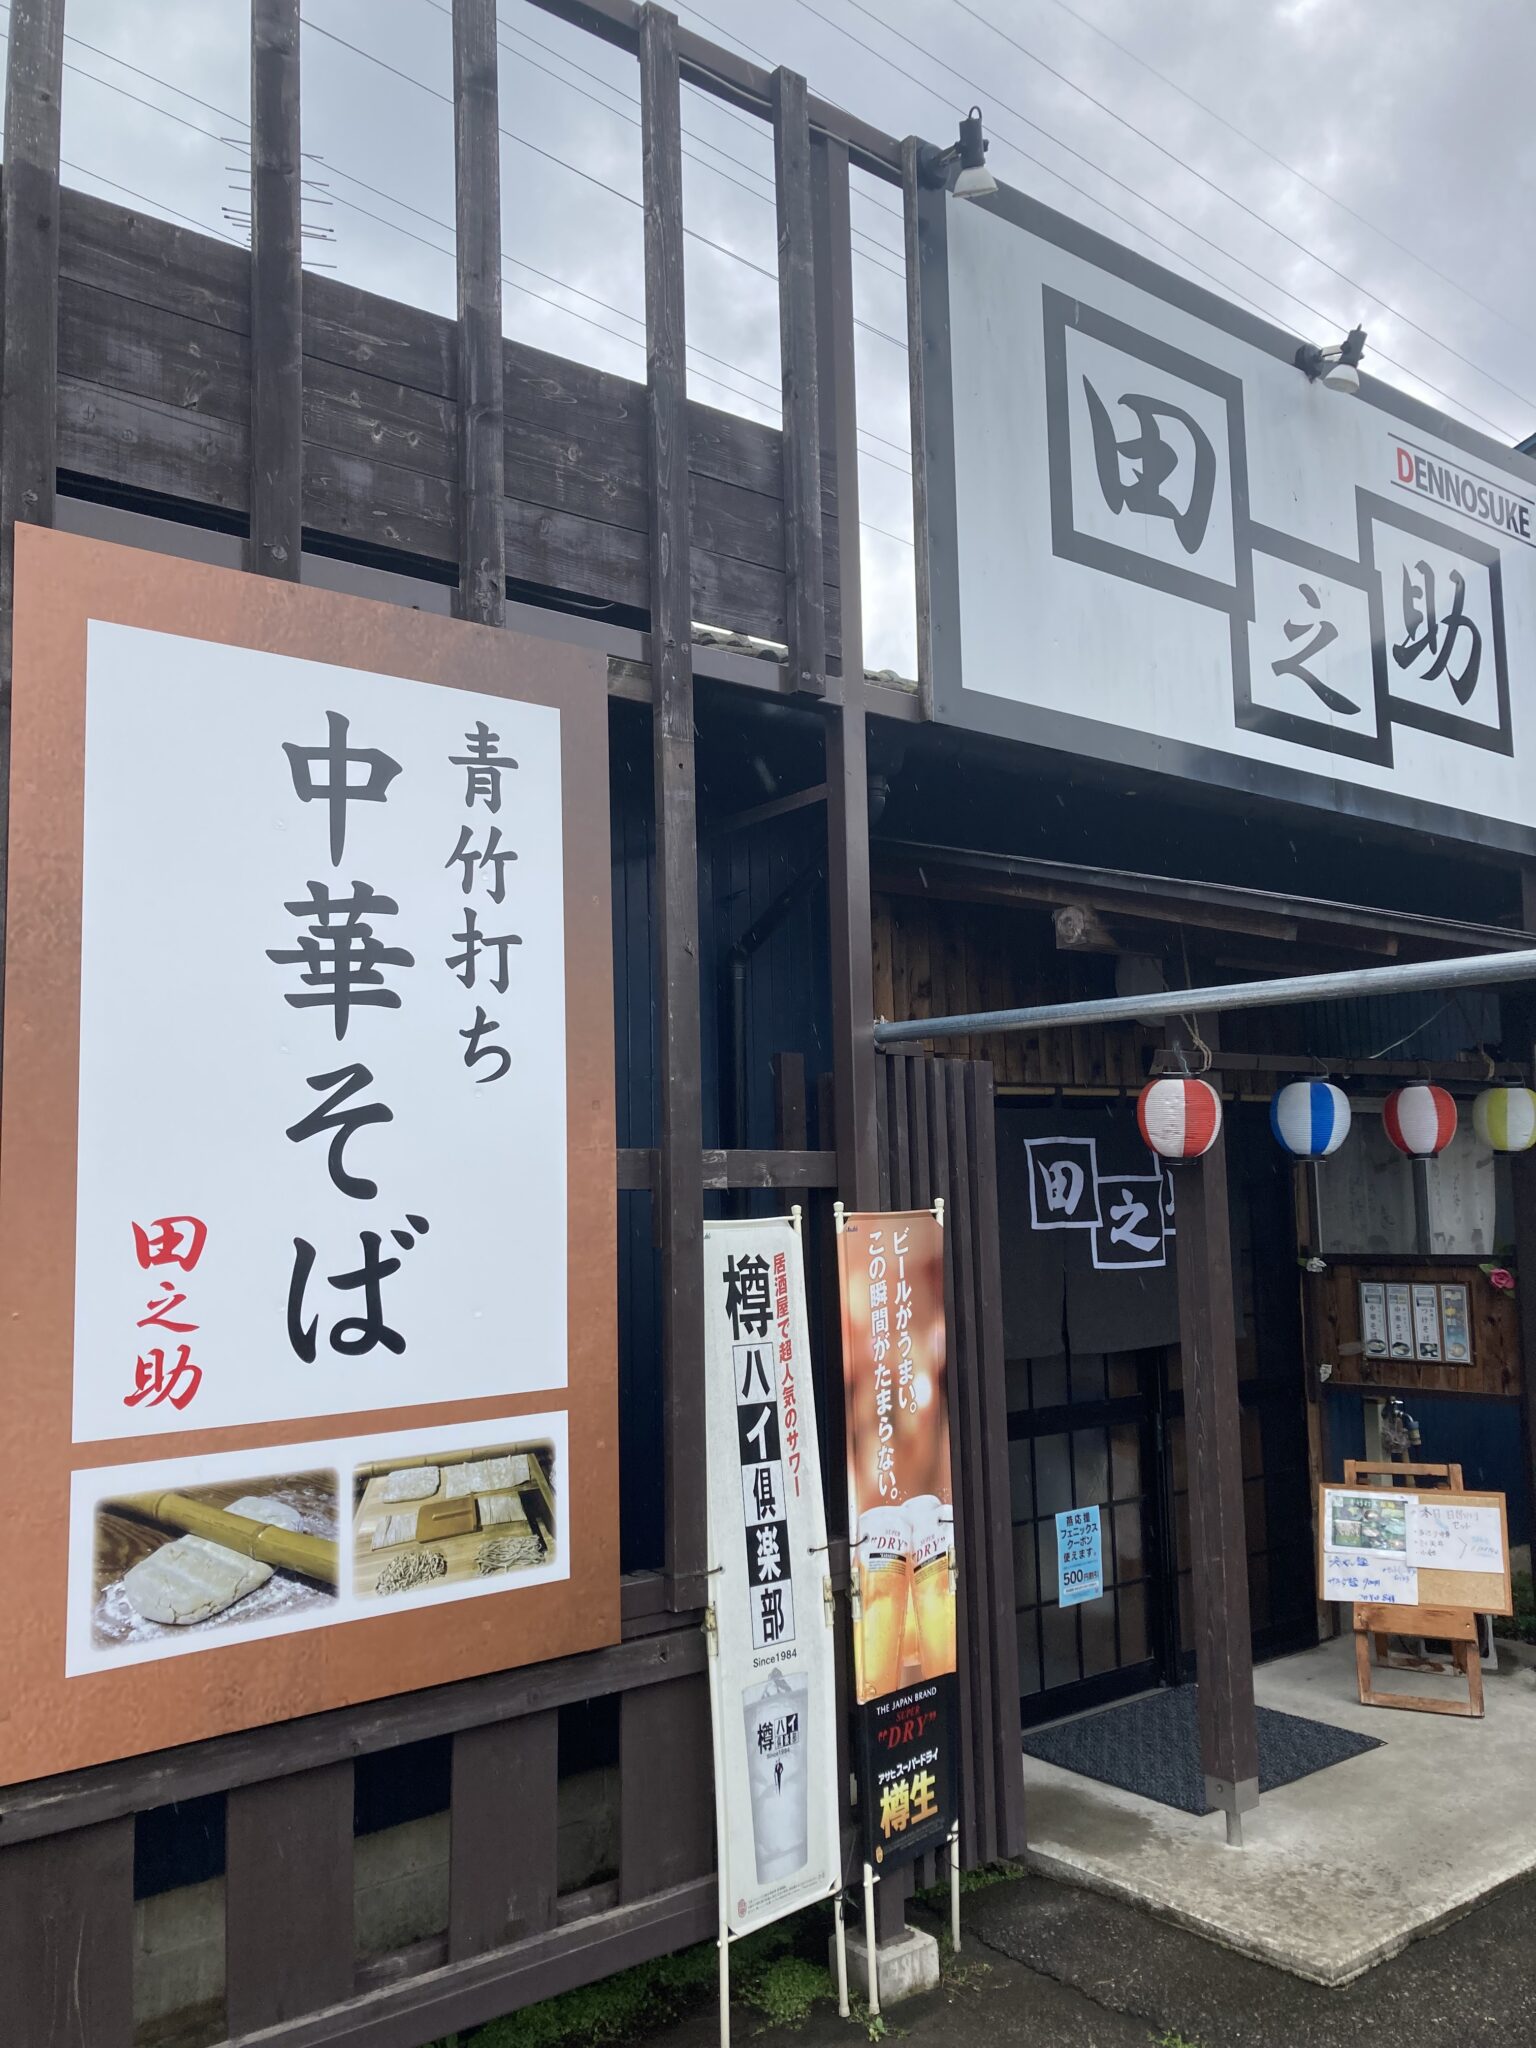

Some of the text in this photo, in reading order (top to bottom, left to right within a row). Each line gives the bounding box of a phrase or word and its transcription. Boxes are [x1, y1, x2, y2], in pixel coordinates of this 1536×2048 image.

[1082, 373, 1482, 715] 田之助
[1396, 447, 1531, 539] DENNOSUKE
[444, 720, 523, 1084] 青竹打ち
[265, 710, 430, 1365] 中華そば
[1037, 1160, 1175, 1252] 田之
[123, 1215, 208, 1412] 田之助
[773, 1252, 802, 1498] 居酒屋で超人気のサワー
[868, 1230, 899, 1500] この瞬間がたまらない。
[893, 1226, 917, 1415] ビールがうまい。
[1060, 1523, 1098, 1539] フェニックス
[1067, 1536, 1093, 1550] クーポン
[876, 1686, 937, 1716] THE JAPAN BRAND
[878, 1746, 939, 1785] アサヒスーパードライ
[880, 1770, 938, 1839] 樽生
